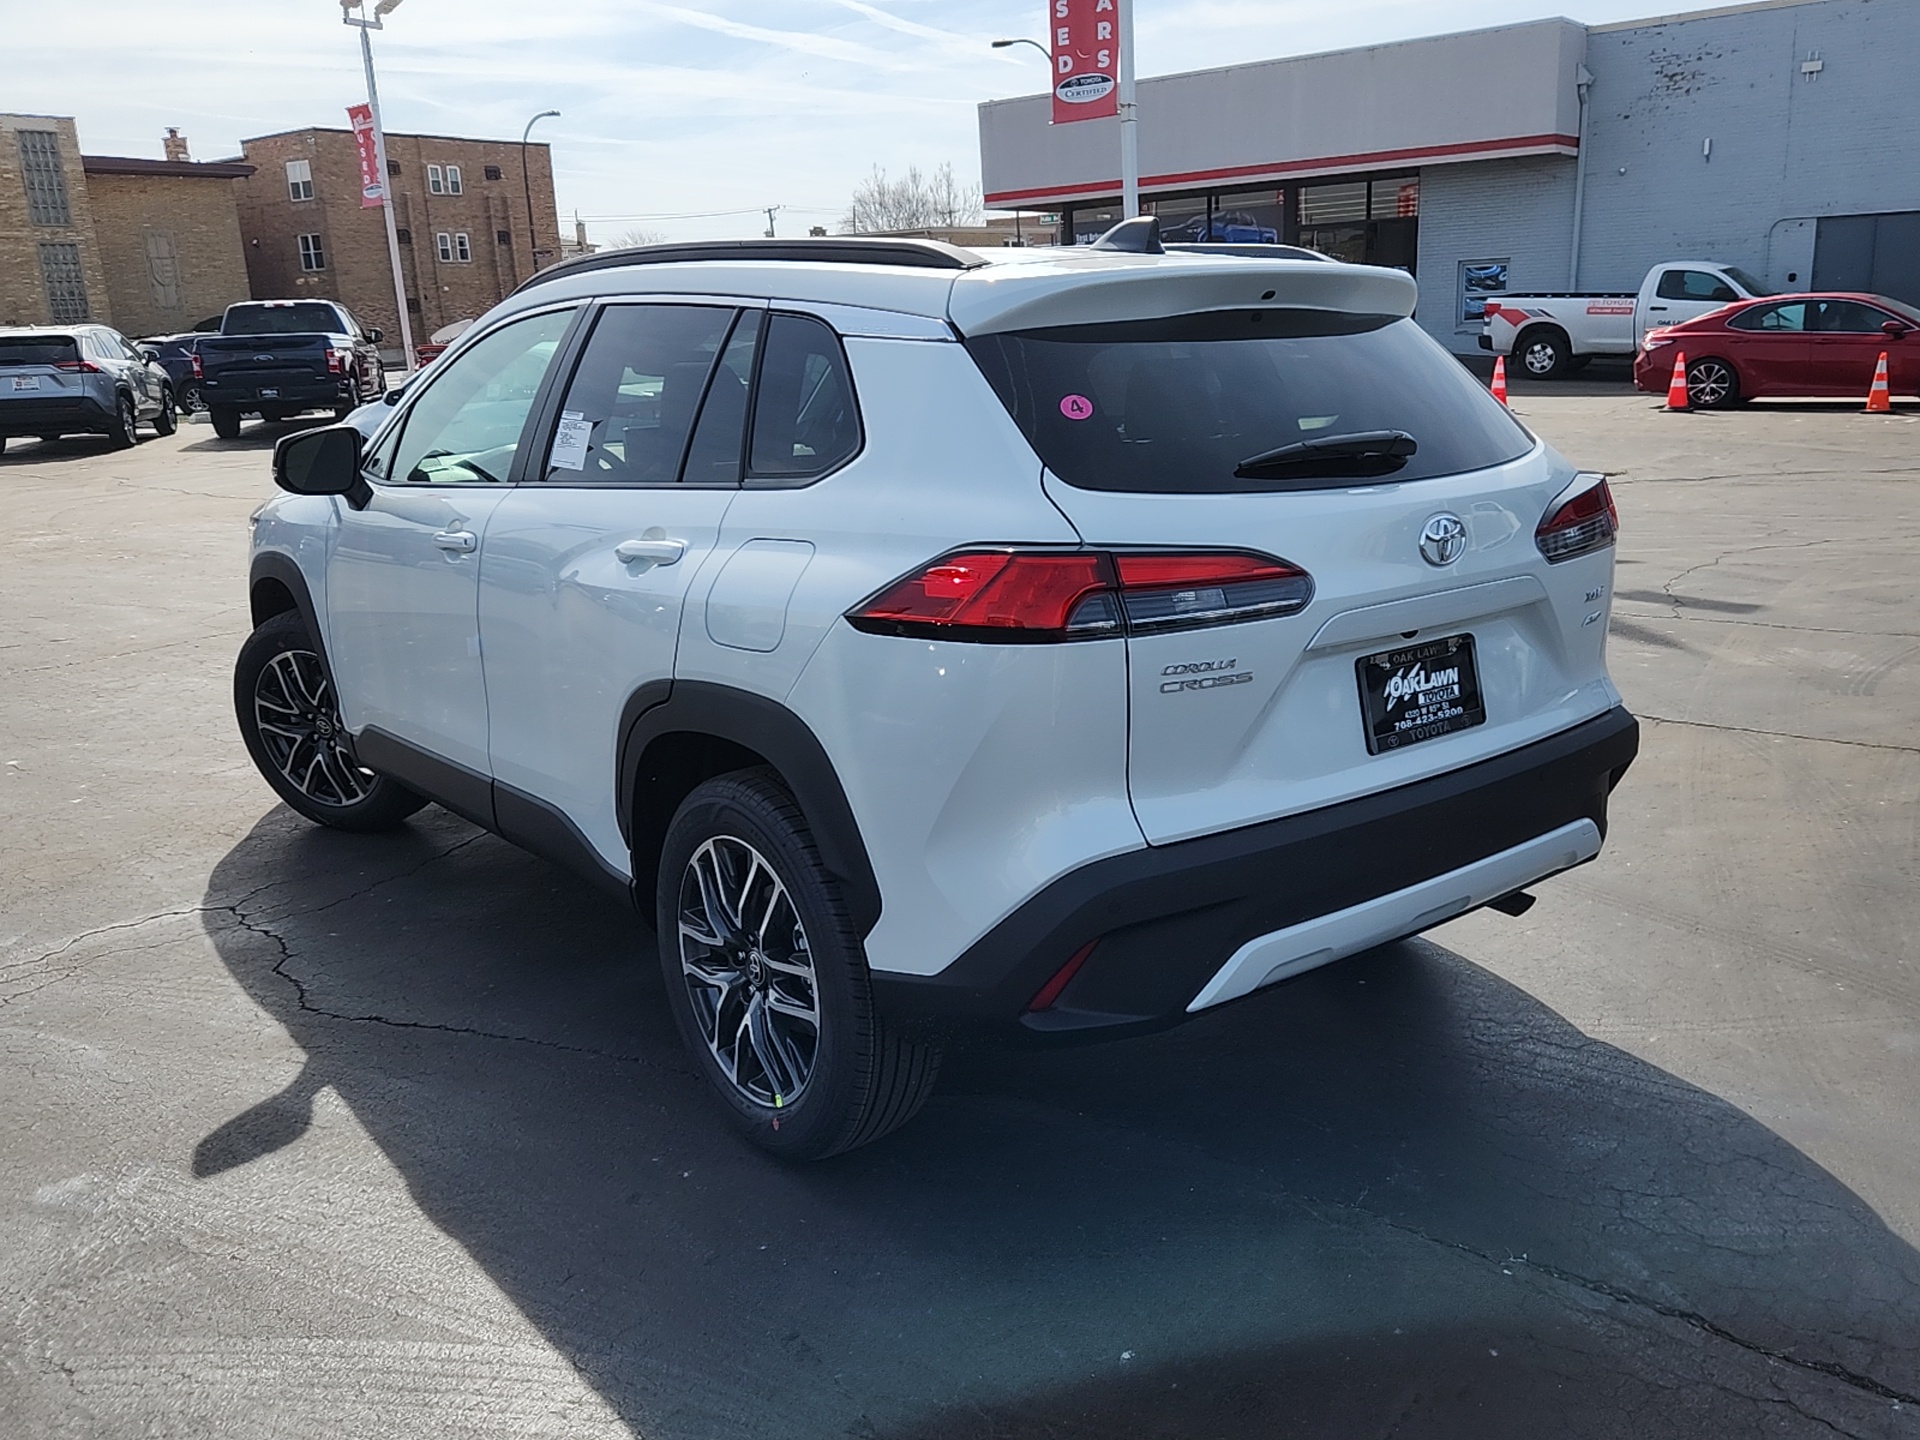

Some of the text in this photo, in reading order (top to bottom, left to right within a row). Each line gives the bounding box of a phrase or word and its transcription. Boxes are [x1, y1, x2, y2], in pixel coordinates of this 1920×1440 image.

[1160, 658, 1237, 676] COROLLA
[1392, 652, 1414, 664] OAK
[1160, 671, 1254, 694] CROSS
[1422, 686, 1456, 702] TOYOTA
[1393, 706, 1464, 732] 708-423-5200
[1409, 720, 1452, 741] TOYOTA
